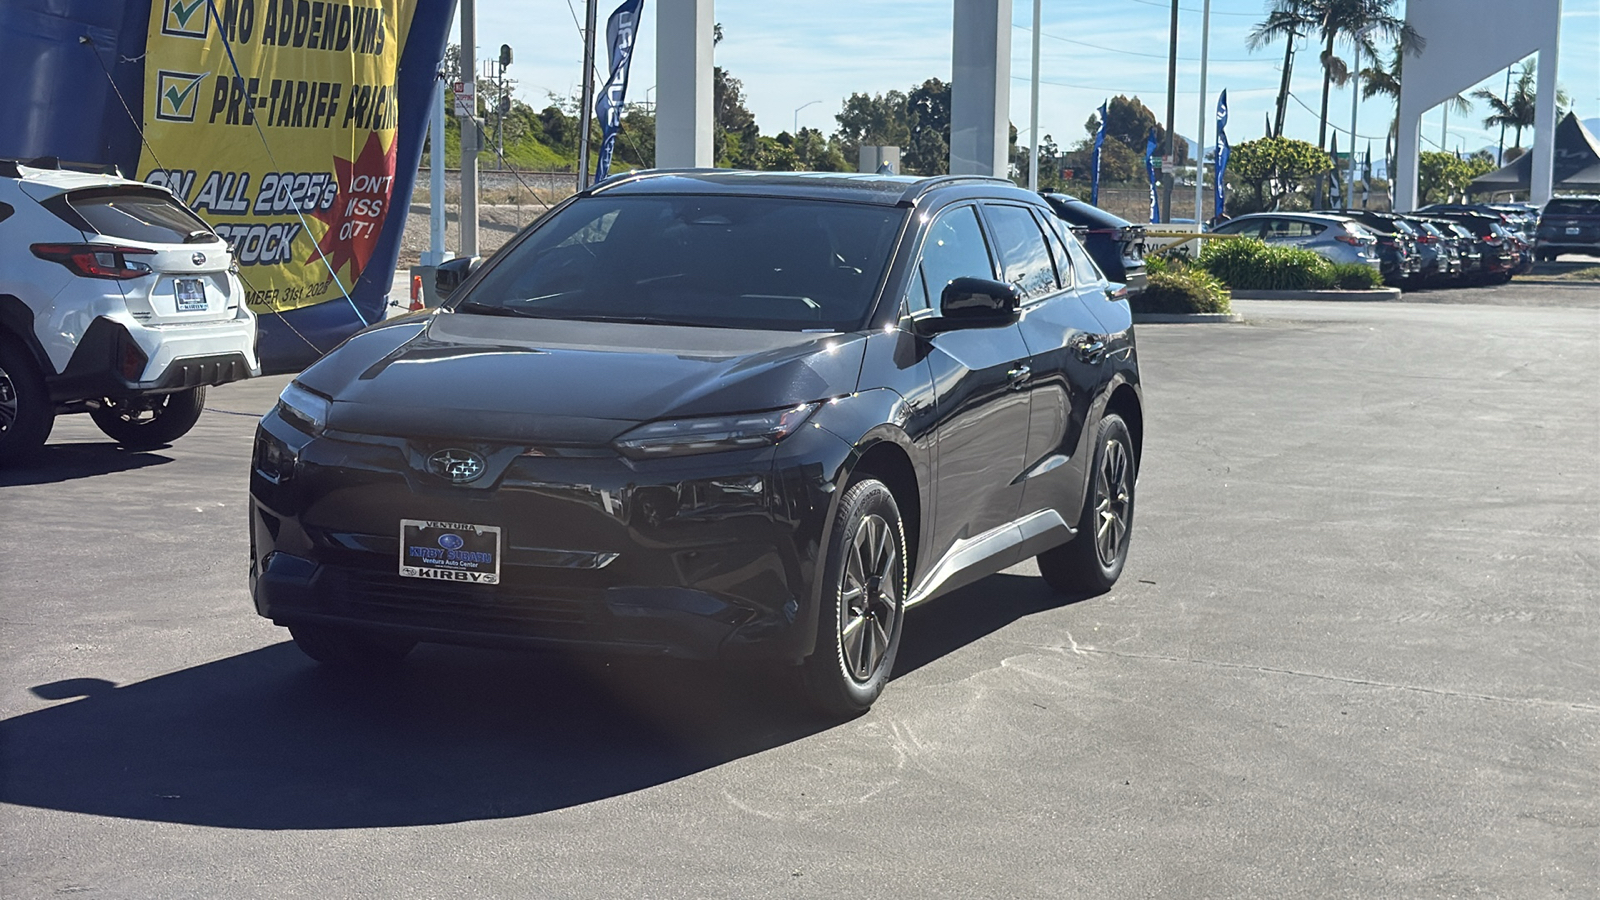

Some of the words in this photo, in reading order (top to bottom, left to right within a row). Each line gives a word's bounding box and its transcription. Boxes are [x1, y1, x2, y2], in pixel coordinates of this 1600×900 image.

[223, 0, 254, 45] NO
[262, 0, 386, 56] ADDENDUMS
[208, 75, 342, 129] PRE-TARIFF
[190, 170, 251, 216] ALL
[253, 172, 338, 216] 2025's
[344, 197, 383, 218] ISS
[245, 288, 280, 305] MBER
[426, 521, 476, 530] VENTURA
[409, 546, 445, 558] KIRBY
[447, 550, 492, 563] SUBARU
[422, 557, 444, 565] Ventura
[445, 559, 459, 567] Auto
[418, 569, 482, 581] KIRBY
